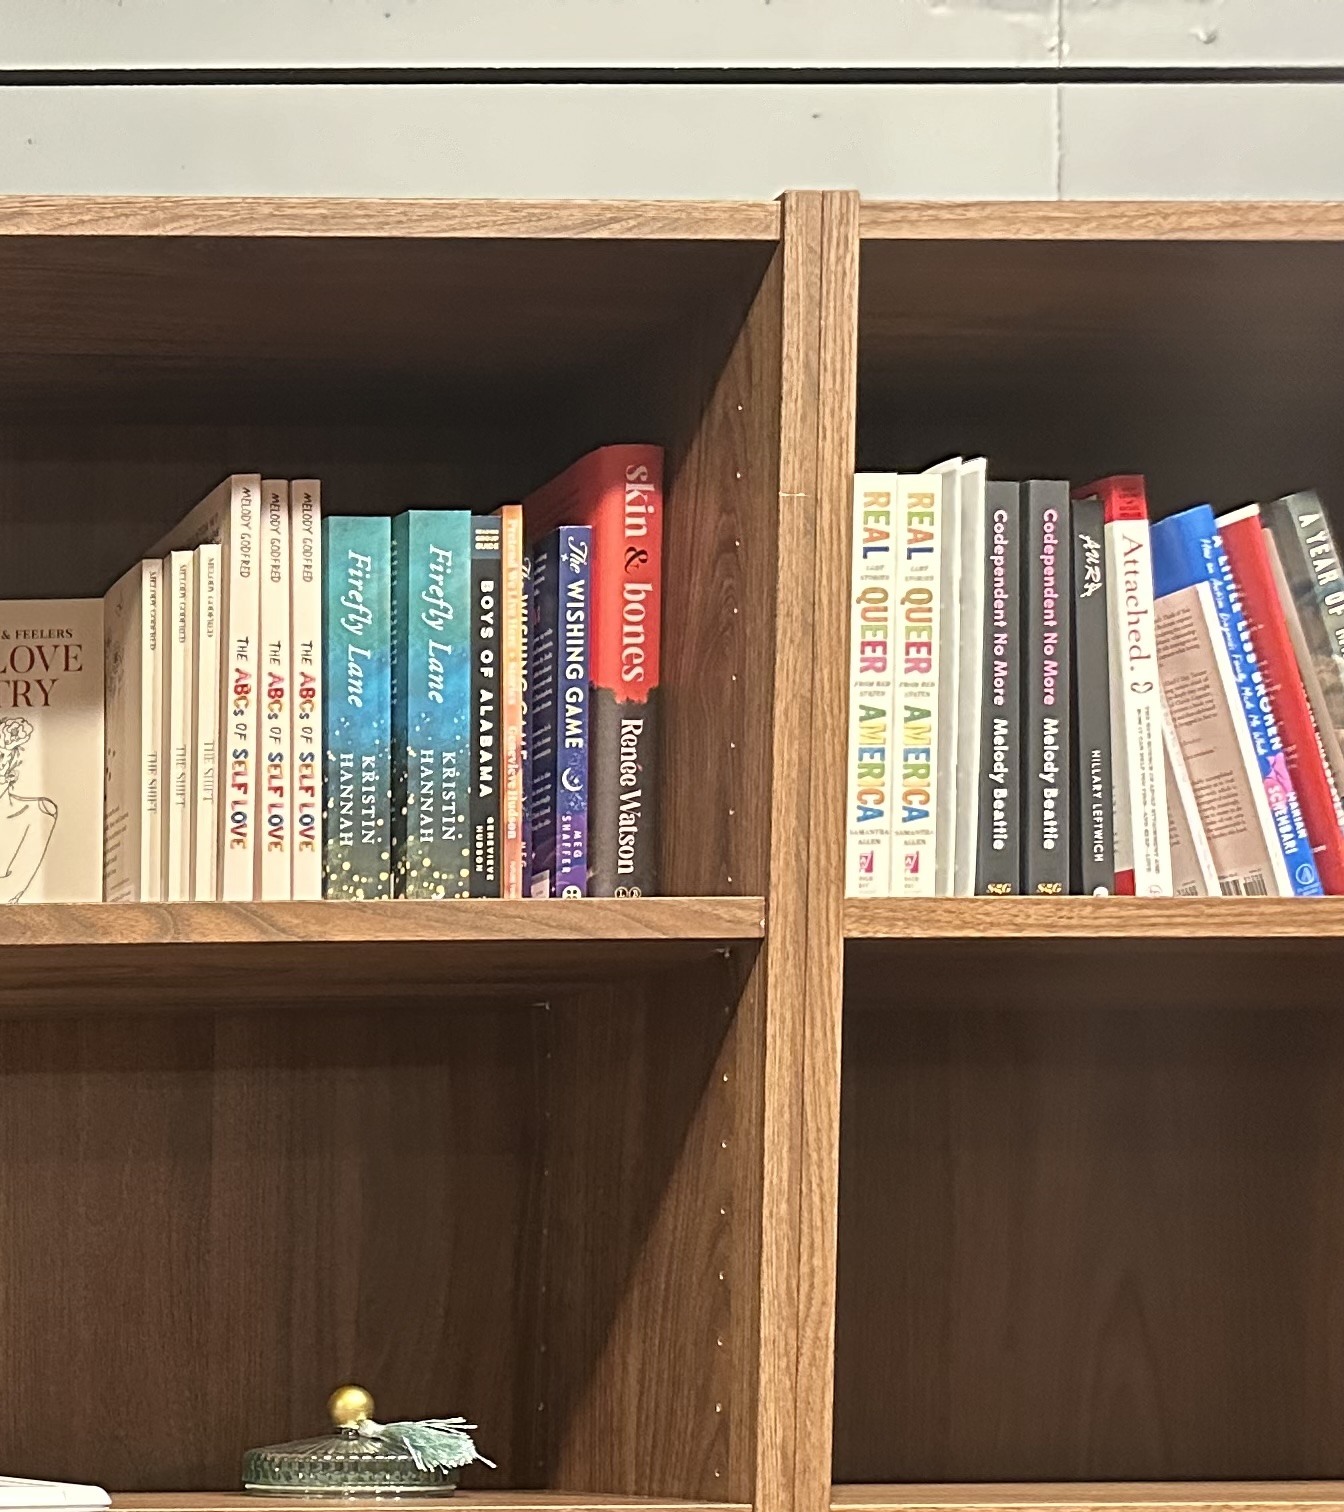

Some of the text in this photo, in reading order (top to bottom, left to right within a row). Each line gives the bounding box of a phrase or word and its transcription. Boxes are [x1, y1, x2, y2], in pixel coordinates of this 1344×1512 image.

[621, 464, 656, 683] skin & bones
[862, 492, 890, 559] REAL
[1, 630, 10, 640] &
[15, 629, 73, 640] FEELERS
[421, 543, 453, 705] Firefly Lane
[856, 586, 889, 674] QUEER
[1121, 533, 1151, 672] Attached.
[480, 580, 494, 798] BOYS OF ALABAMA
[989, 509, 1009, 850] Codependent No More Melody Beattie
[420, 749, 434, 843] HANNAH
[441, 751, 457, 842] KRISTIN
[617, 718, 643, 875] Renée Watson
[856, 704, 886, 823] AMERICA
[1091, 750, 1104, 862] HILLARY LEFTWICH
